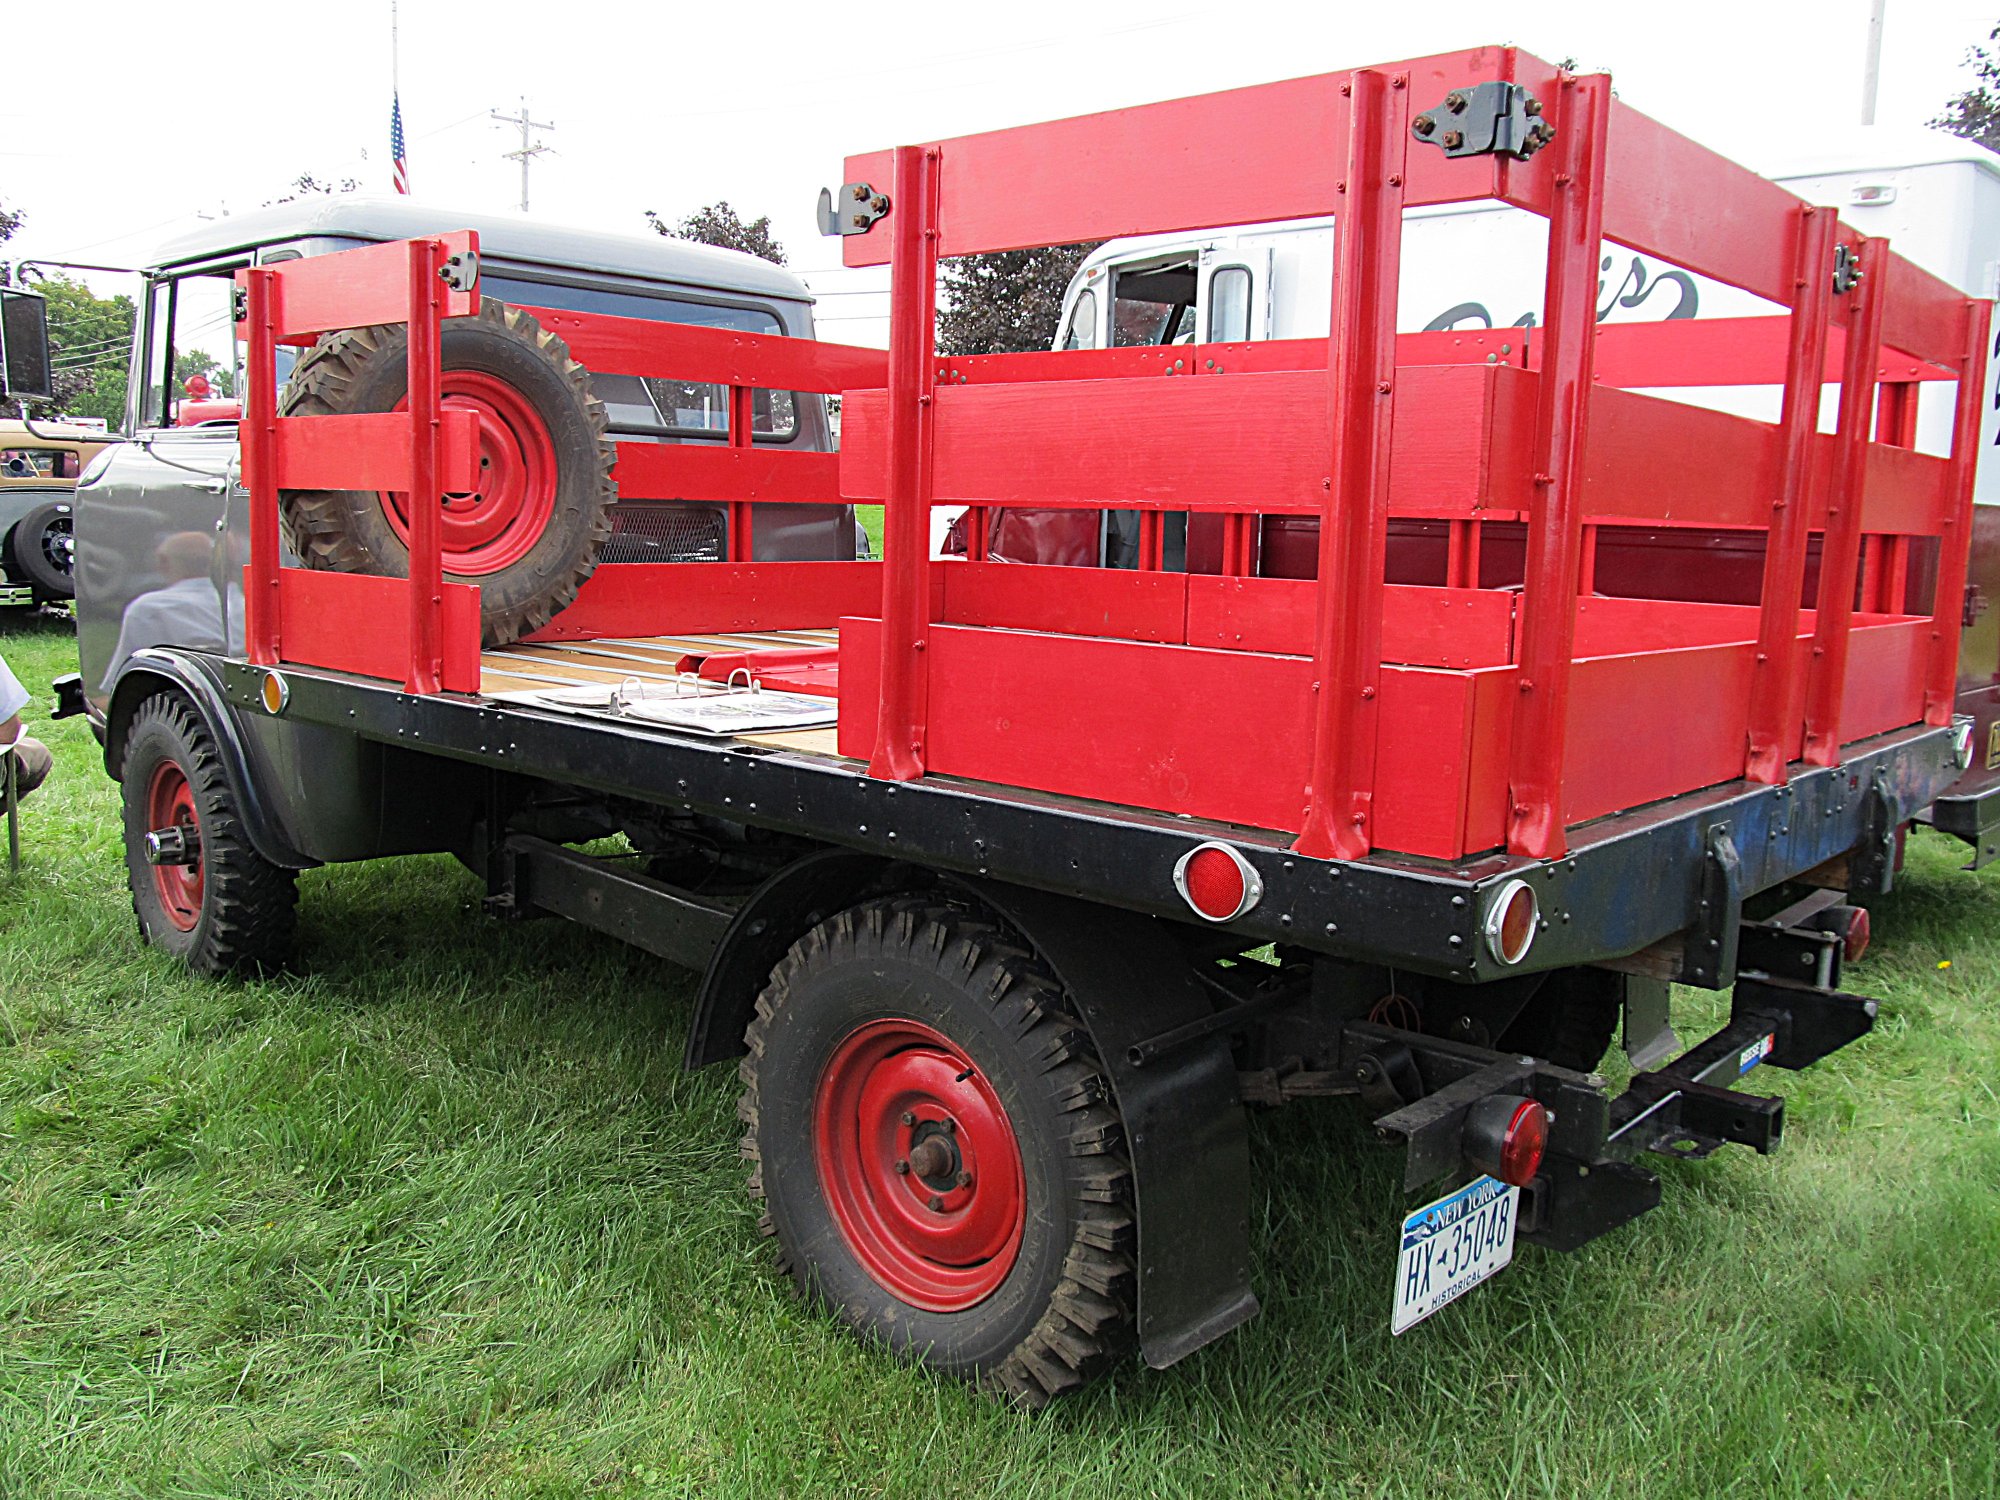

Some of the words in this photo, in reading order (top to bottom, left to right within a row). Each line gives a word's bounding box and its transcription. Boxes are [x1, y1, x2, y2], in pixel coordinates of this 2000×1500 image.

[1435, 1198, 1466, 1232] NEW
[1467, 1180, 1497, 1212] YORK
[1405, 1239, 1436, 1306] HX
[1448, 1195, 1510, 1278] 35048
[1431, 1269, 1481, 1309] HISTORICAL
